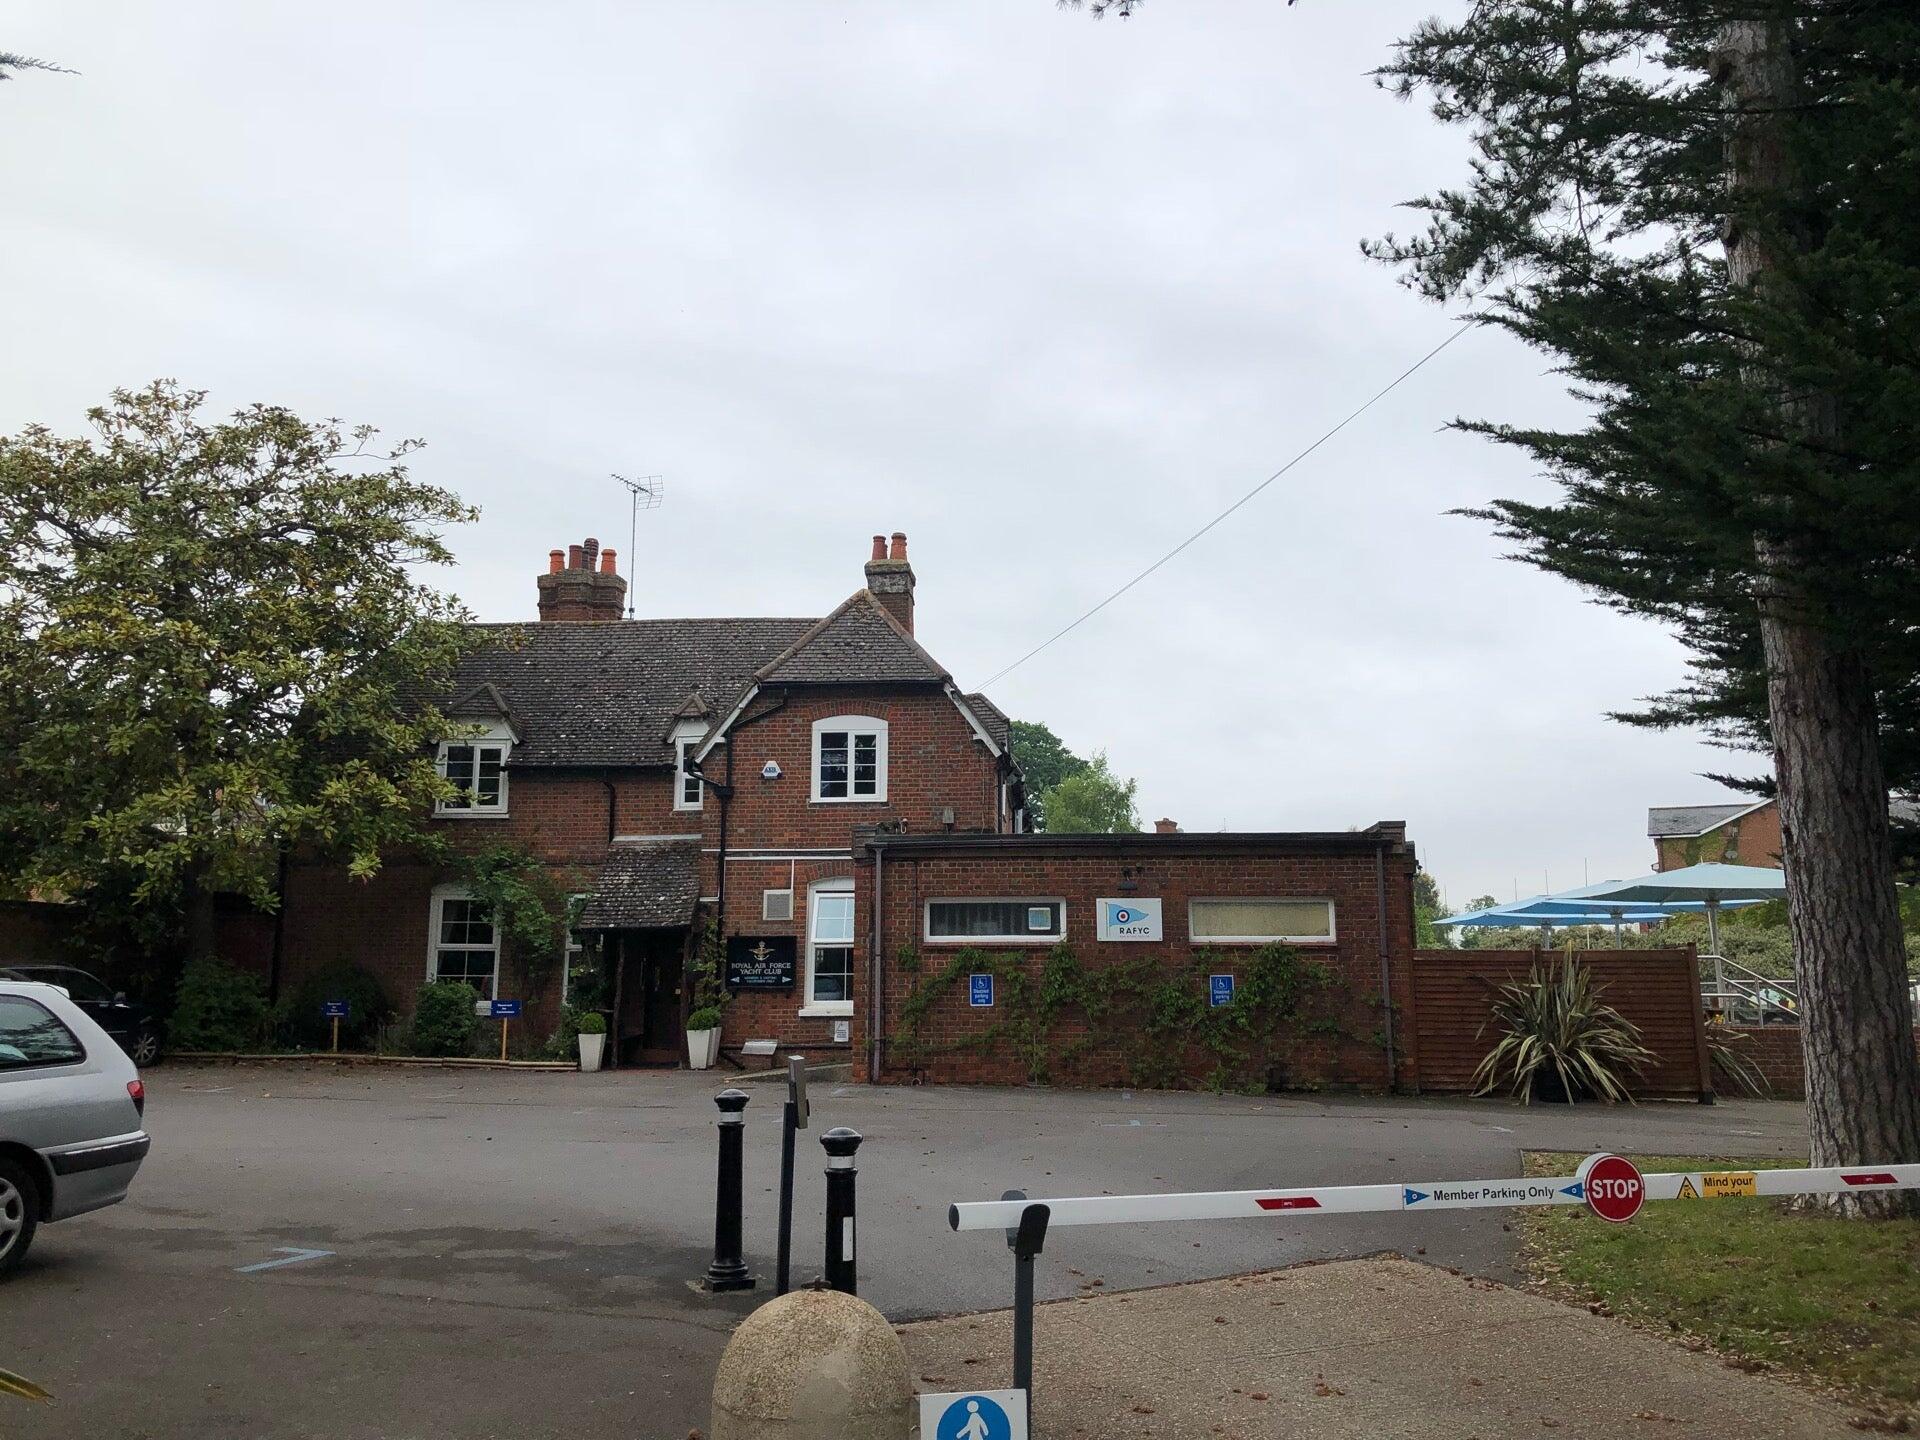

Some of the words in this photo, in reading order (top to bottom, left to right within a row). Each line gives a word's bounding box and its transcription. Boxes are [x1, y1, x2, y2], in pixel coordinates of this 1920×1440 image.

[1120, 927, 1150, 935] RAFYC
[1591, 1178, 1639, 1199] STOP
[1703, 1176, 1729, 1187] Mind
[1731, 1176, 1753, 1189] your
[1433, 1189, 1479, 1201] Member
[1482, 1187, 1526, 1200] Parking
[1528, 1187, 1555, 1199] Only
